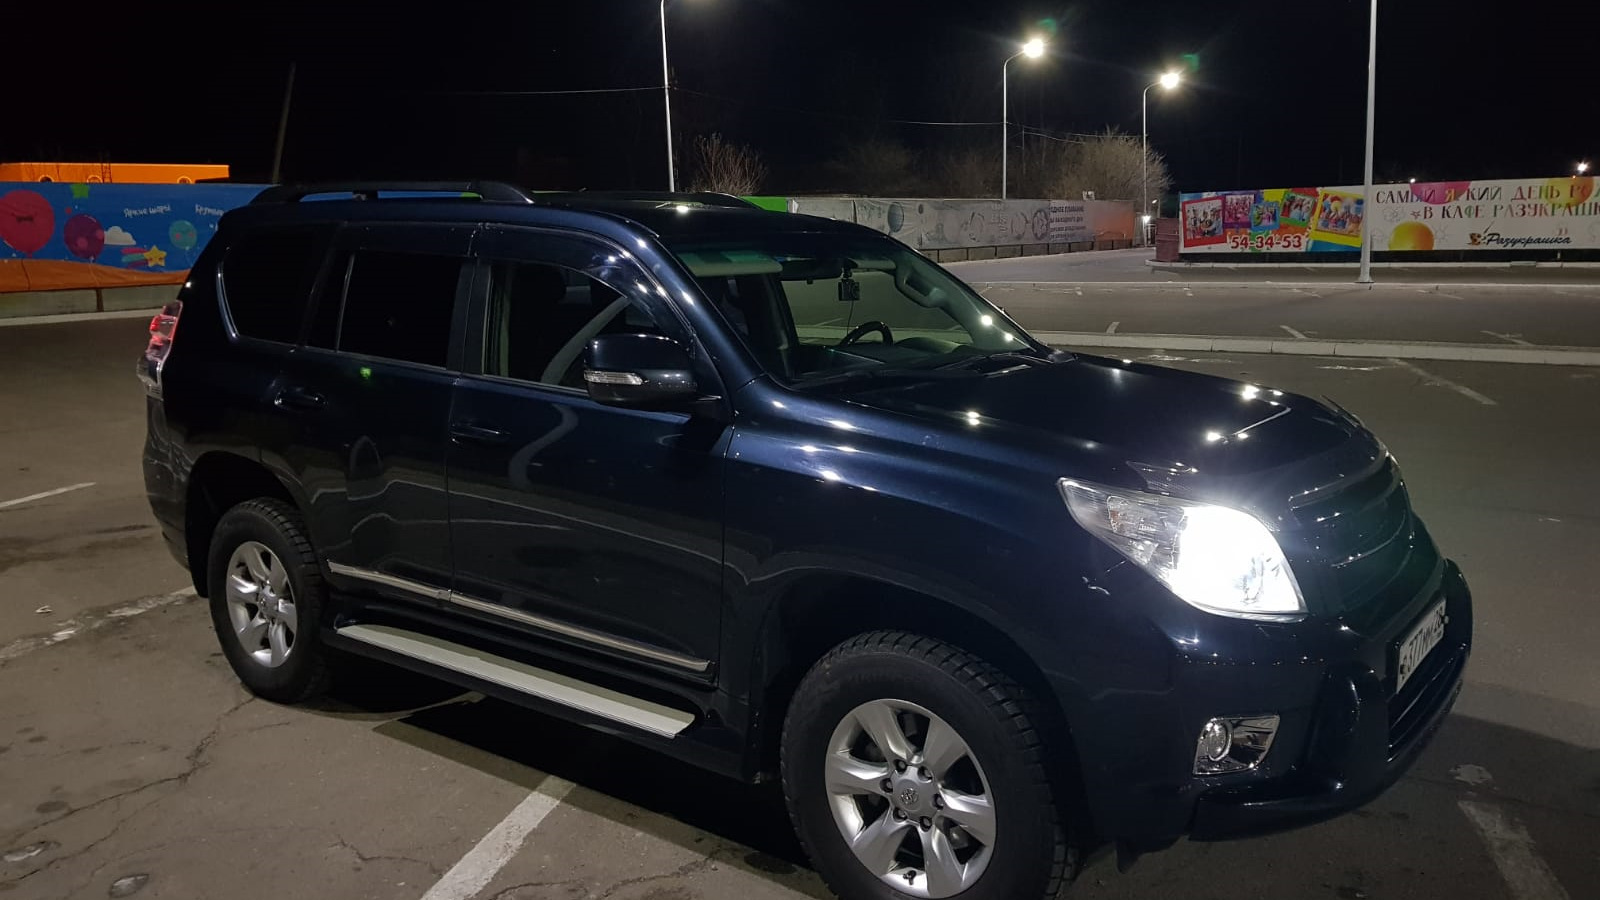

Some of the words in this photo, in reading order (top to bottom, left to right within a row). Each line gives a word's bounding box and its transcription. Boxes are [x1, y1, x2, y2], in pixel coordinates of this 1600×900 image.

[1377, 187, 1435, 204] САМЫЙ
[1510, 185, 1560, 202] ДЕНЬ
[1570, 184, 1600, 200] РО
[1423, 206, 1433, 219] В
[1442, 204, 1484, 219] КАФЕ
[1230, 235, 1302, 249] 54-34-53
[1486, 232, 1572, 248] Разукрашка
